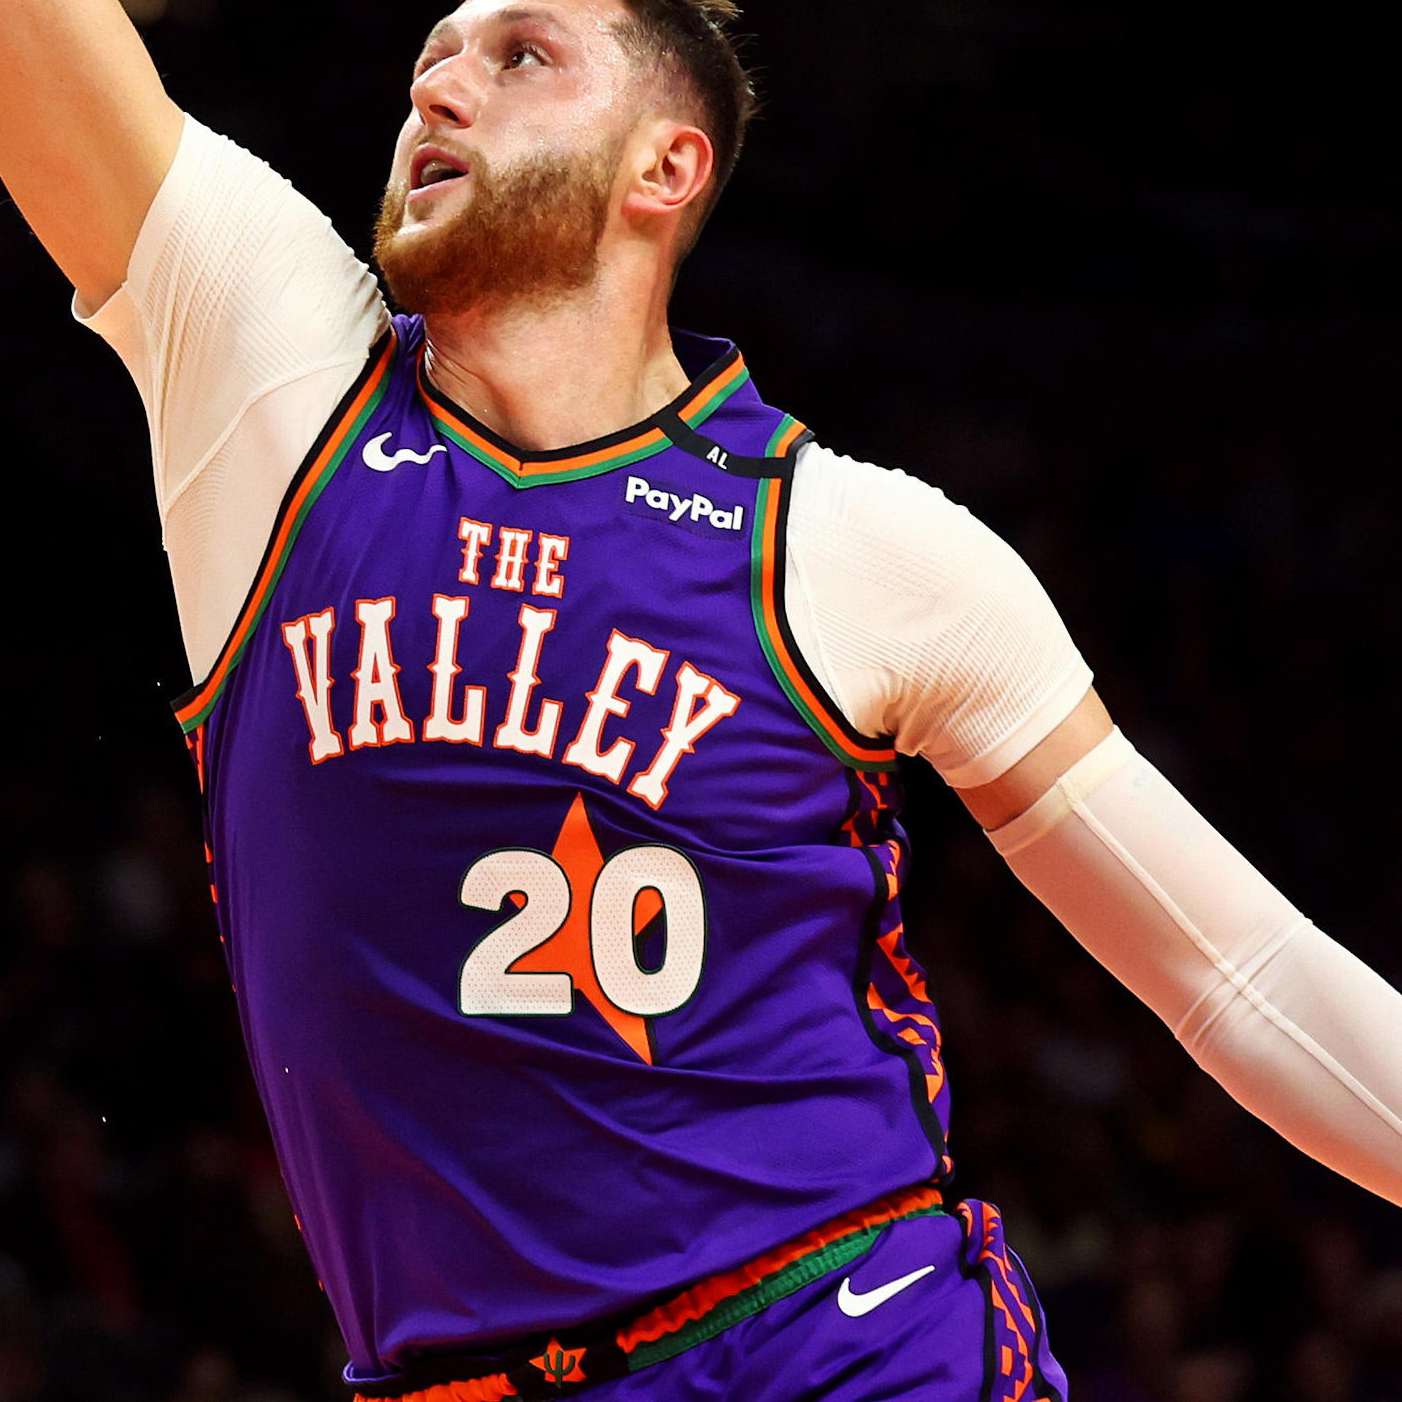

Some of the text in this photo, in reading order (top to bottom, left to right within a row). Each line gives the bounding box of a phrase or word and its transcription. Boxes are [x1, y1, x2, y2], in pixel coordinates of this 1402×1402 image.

[706, 445, 728, 470] AL
[624, 475, 744, 531] PayPal
[457, 516, 570, 598] THE
[282, 593, 741, 810] VALLEY
[458, 843, 707, 1018] 20
